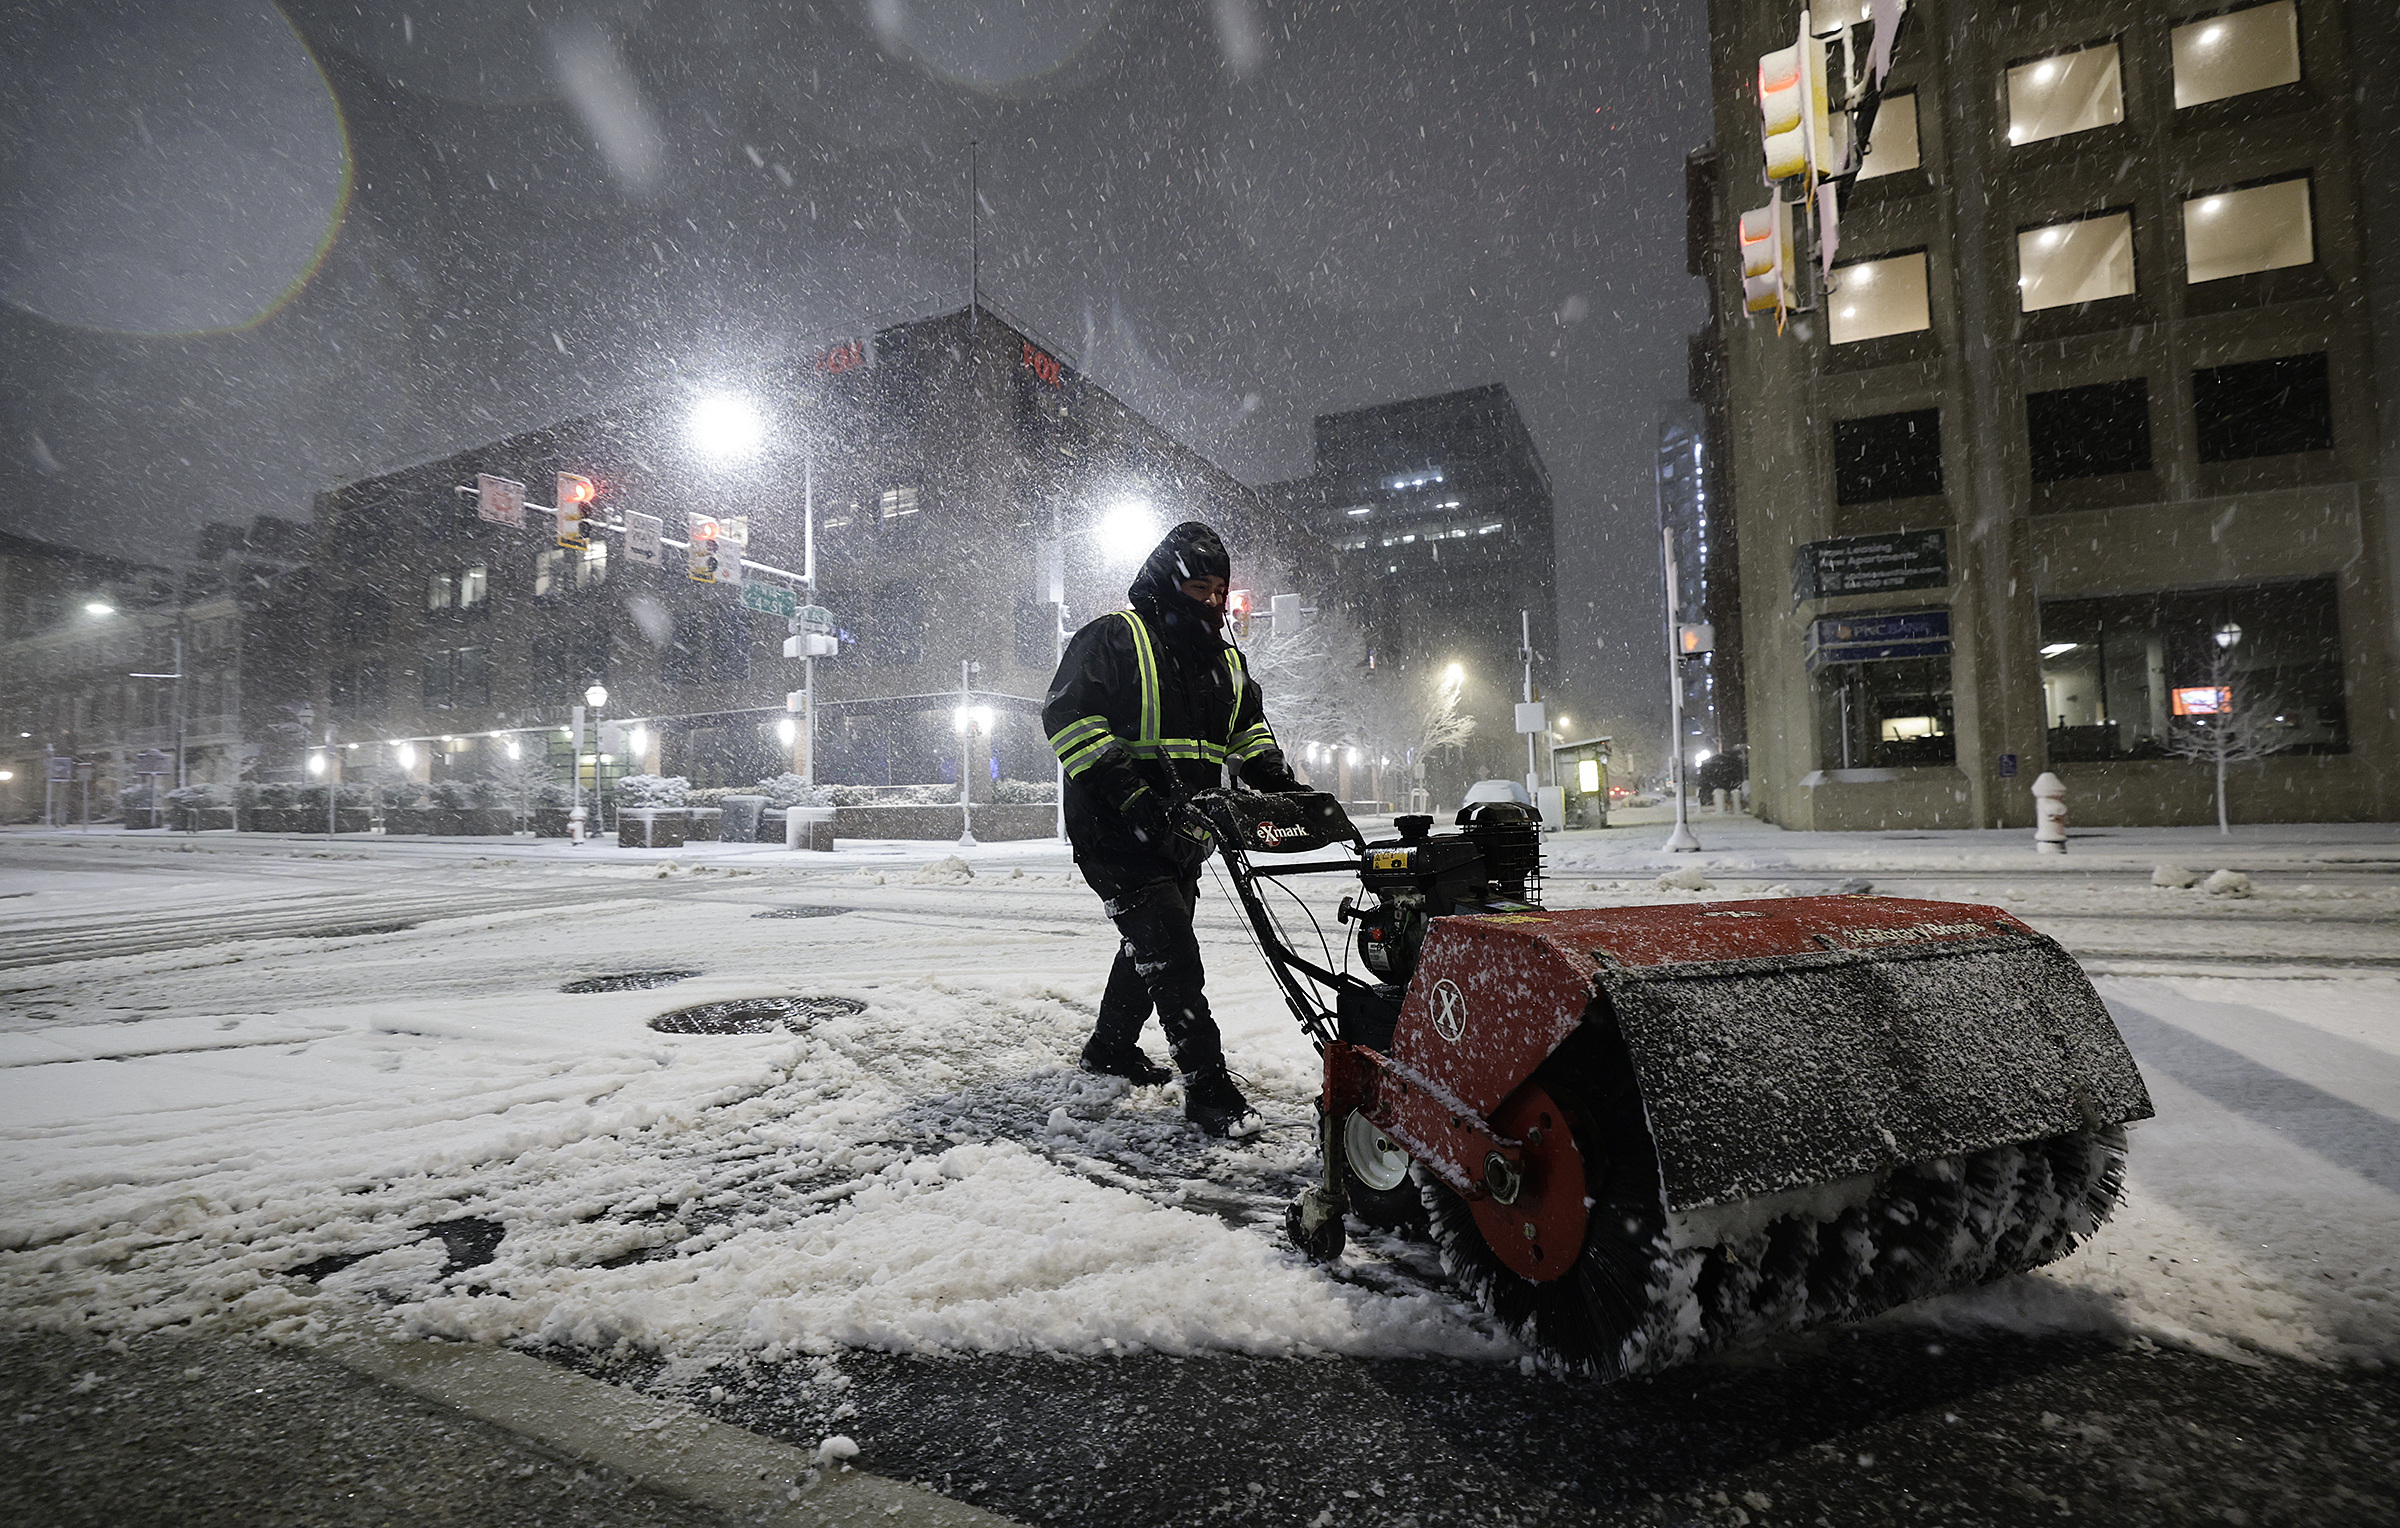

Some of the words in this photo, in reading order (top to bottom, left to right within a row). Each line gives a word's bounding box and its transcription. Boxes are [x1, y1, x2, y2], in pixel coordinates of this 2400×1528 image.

[1022, 341, 1062, 390] FOX
[1846, 544, 1893, 555] Leasing
[1847, 552, 1920, 566] Apartments
[1866, 923, 1933, 942] Rotary
[1924, 922, 1985, 936] Broom
[1436, 986, 1460, 1032] X
